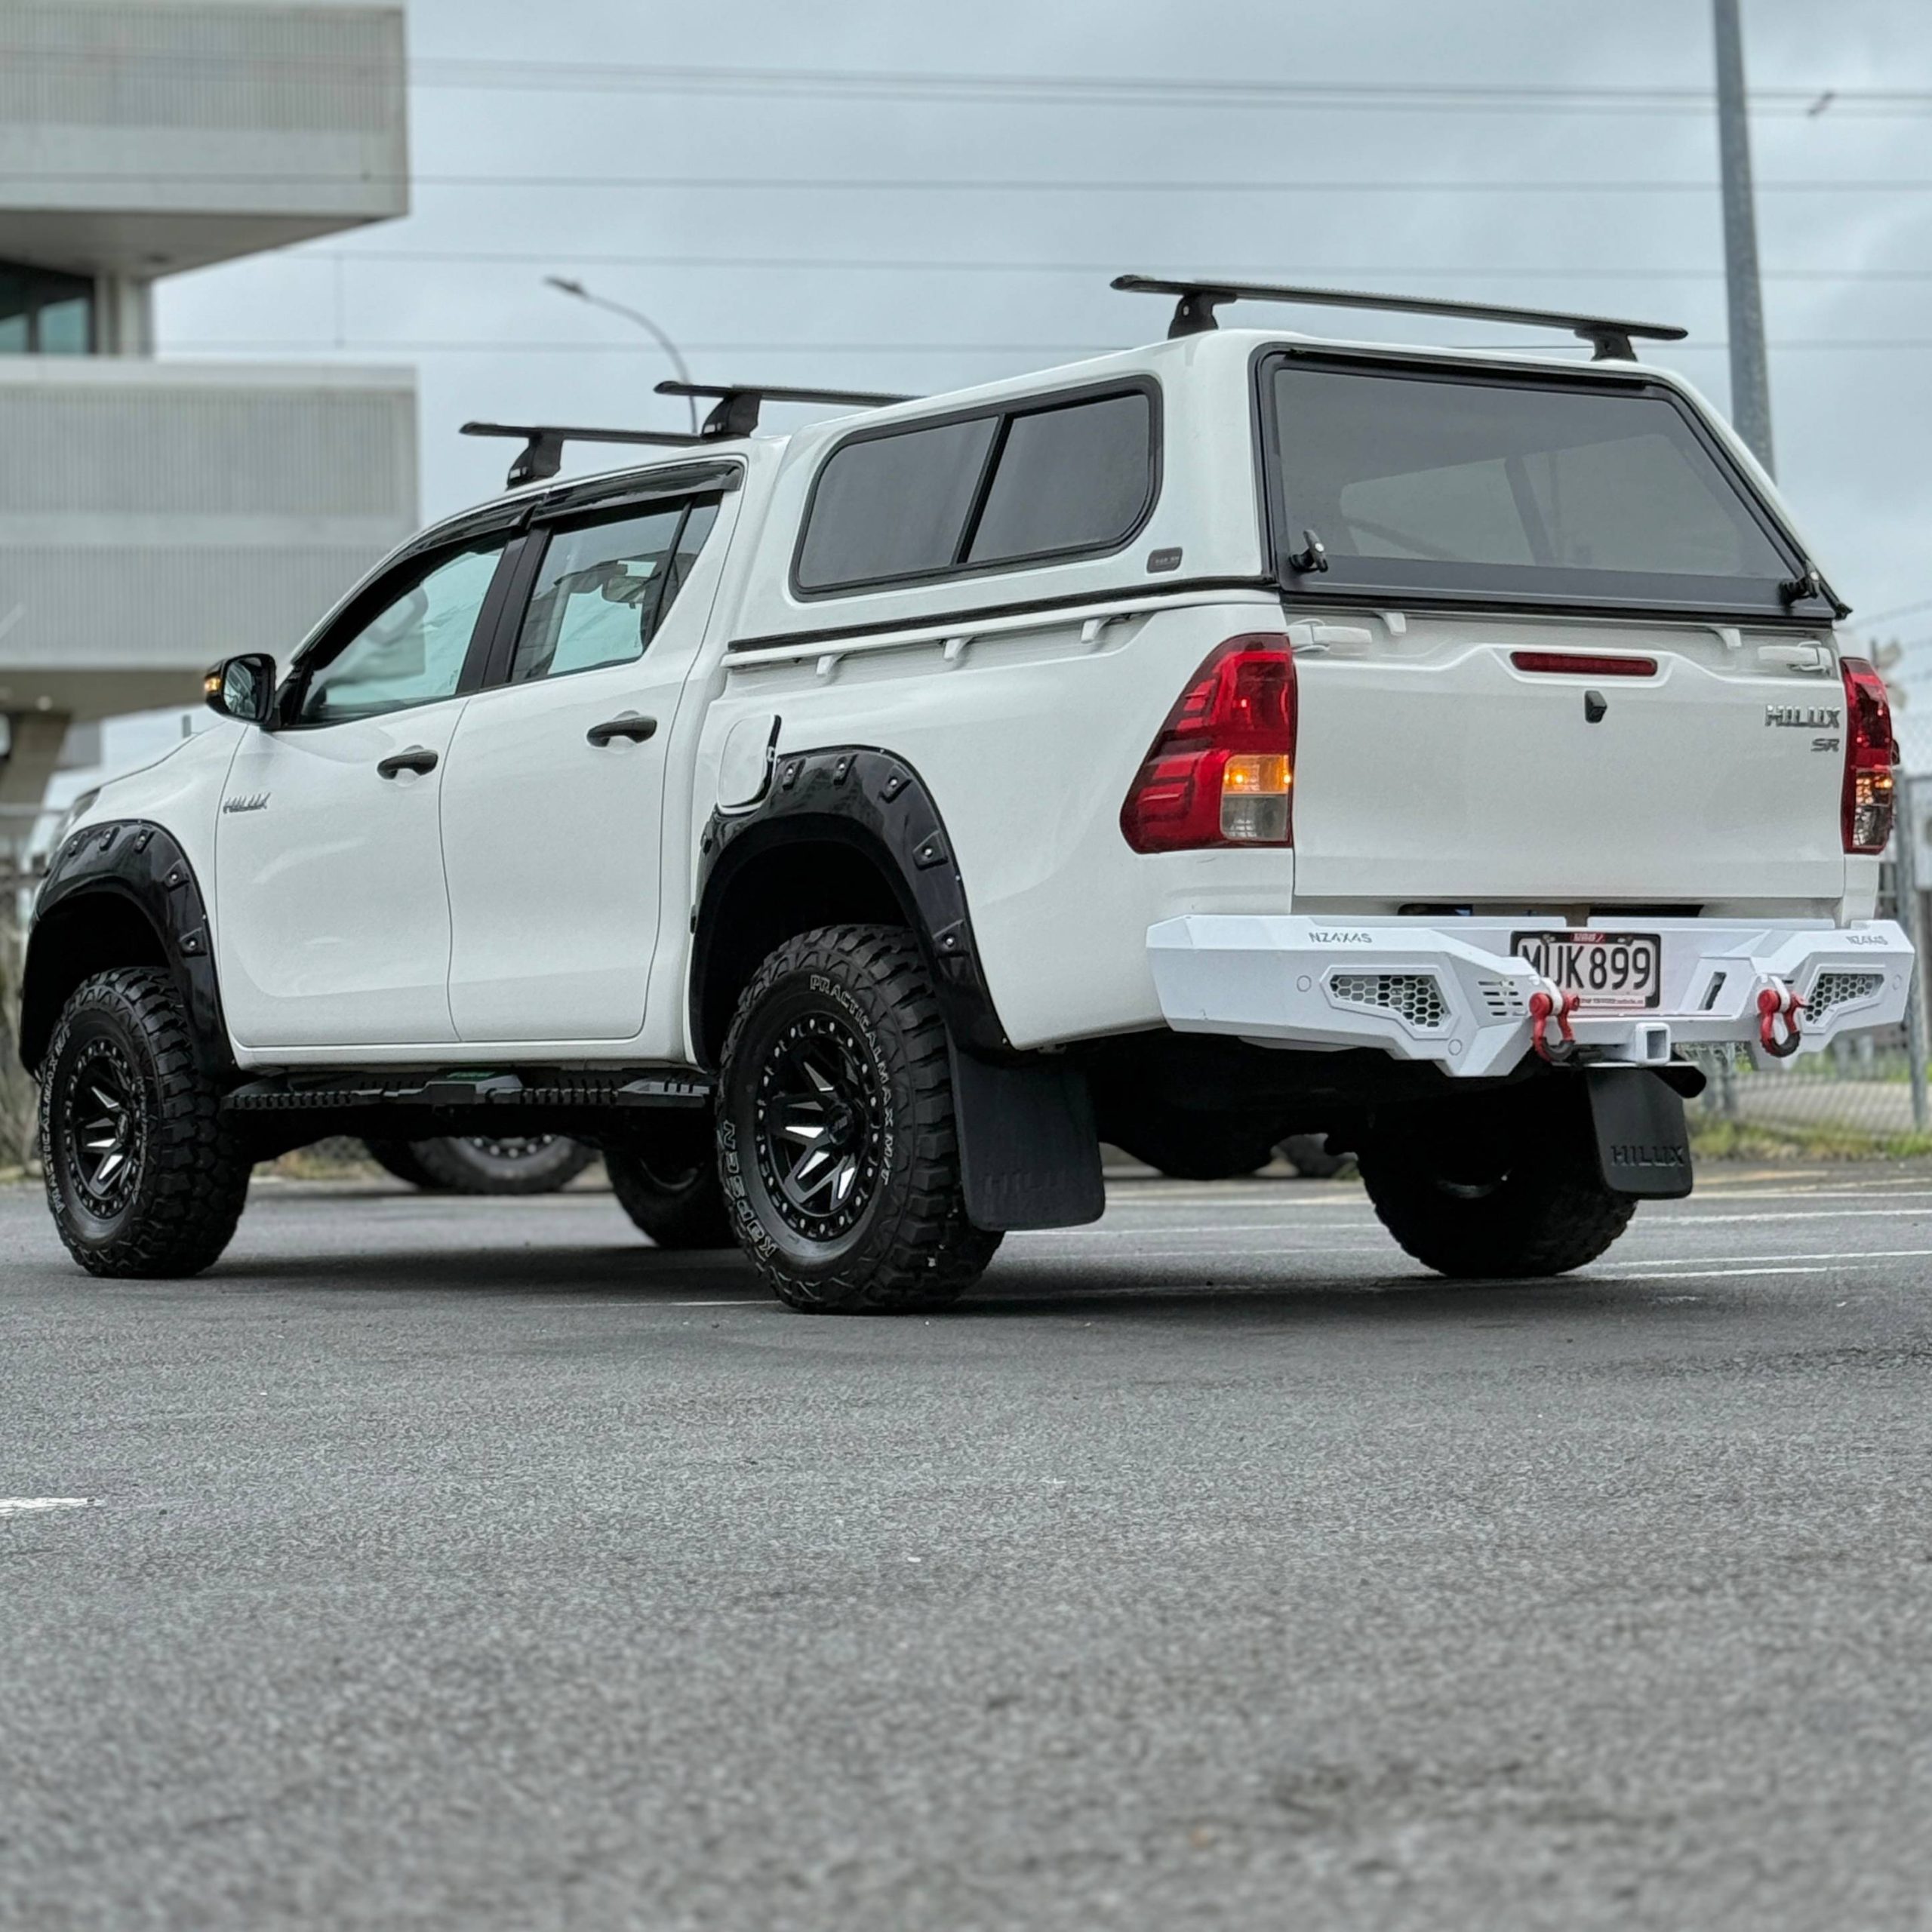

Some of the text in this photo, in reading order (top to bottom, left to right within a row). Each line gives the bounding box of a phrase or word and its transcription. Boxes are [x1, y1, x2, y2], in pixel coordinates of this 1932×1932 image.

[1765, 706, 1840, 728] HILUX
[1810, 738, 1840, 752] SR
[1521, 943, 1651, 990] MUK899
[1611, 1145, 1684, 1167] HILUX
